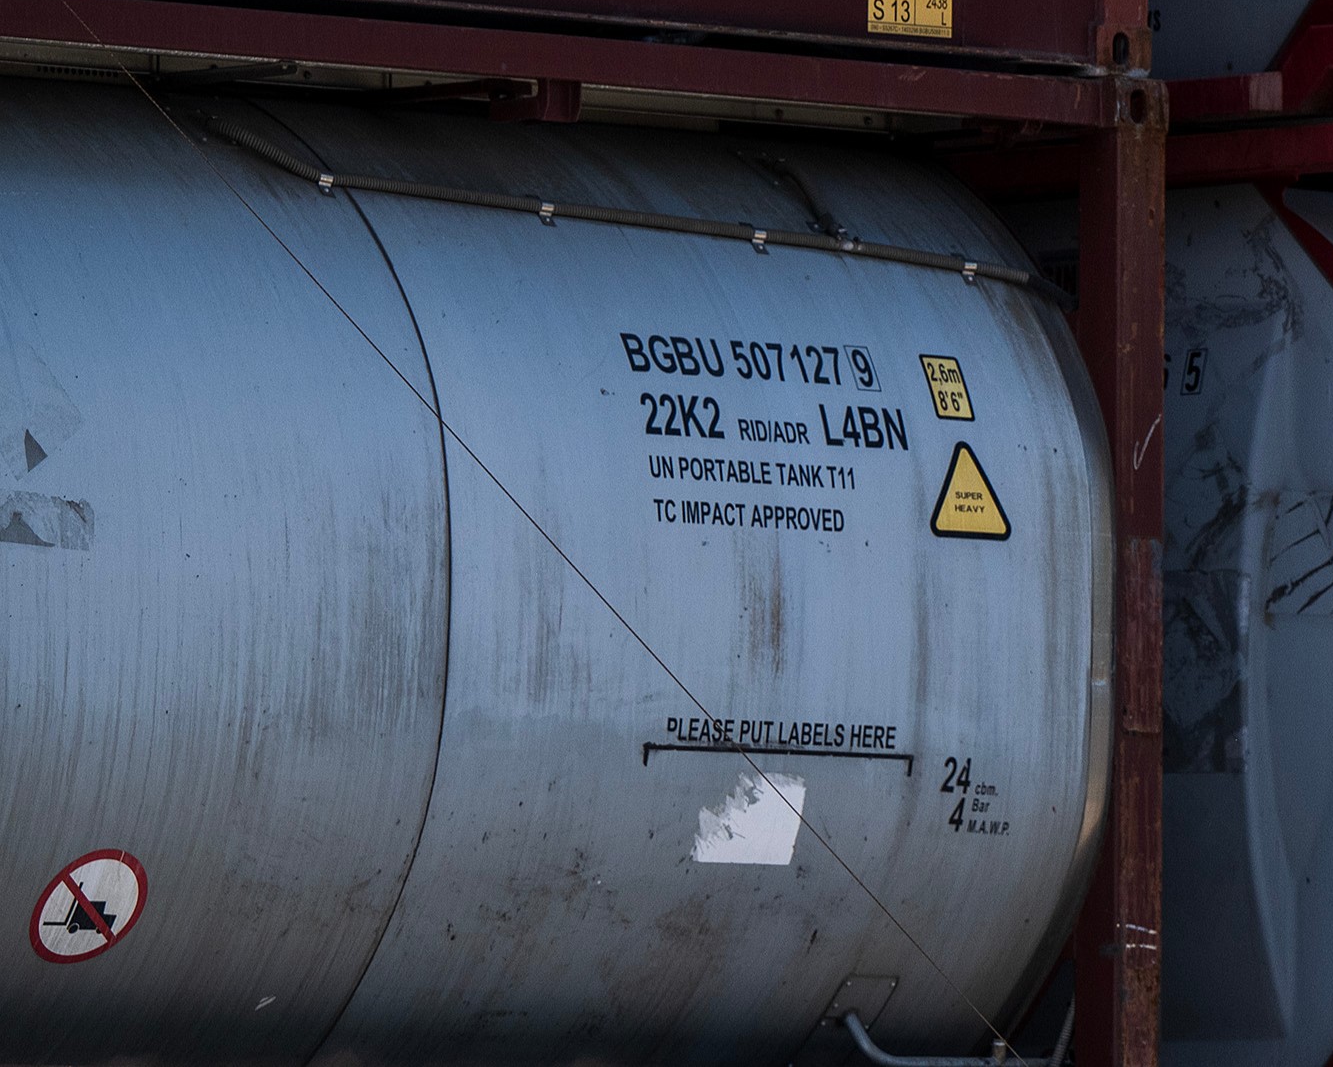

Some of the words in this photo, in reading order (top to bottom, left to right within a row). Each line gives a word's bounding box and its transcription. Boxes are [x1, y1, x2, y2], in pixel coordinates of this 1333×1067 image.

[891, 0, 910, 22] 13
[941, 12, 947, 26] L
[619, 332, 726, 378] BGBU
[730, 340, 842, 386] 507127
[852, 349, 874, 388] 9
[1185, 352, 1201, 392] 5
[639, 392, 726, 440] 22K2
[737, 418, 810, 445] RID/ADR
[819, 403, 909, 451] L4BN
[648, 455, 675, 479] UN
[679, 458, 772, 486] PORTABLE
[776, 463, 824, 489] TANK
[826, 467, 856, 490] T11
[954, 504, 985, 514] HEAVY
[955, 491, 983, 501] SUPER
[653, 499, 677, 523] TC
[681, 500, 745, 528] IMPACT
[750, 506, 845, 532] APPROVED
[667, 717, 735, 744] PLEASE
[738, 720, 775, 745] PUT
[778, 721, 845, 748] LABELS
[849, 724, 897, 750] HERE
[940, 756, 971, 794] 24
[948, 797, 965, 832] 4
[971, 798, 990, 813] Bar
[967, 819, 1010, 836] M.A.W.P.
